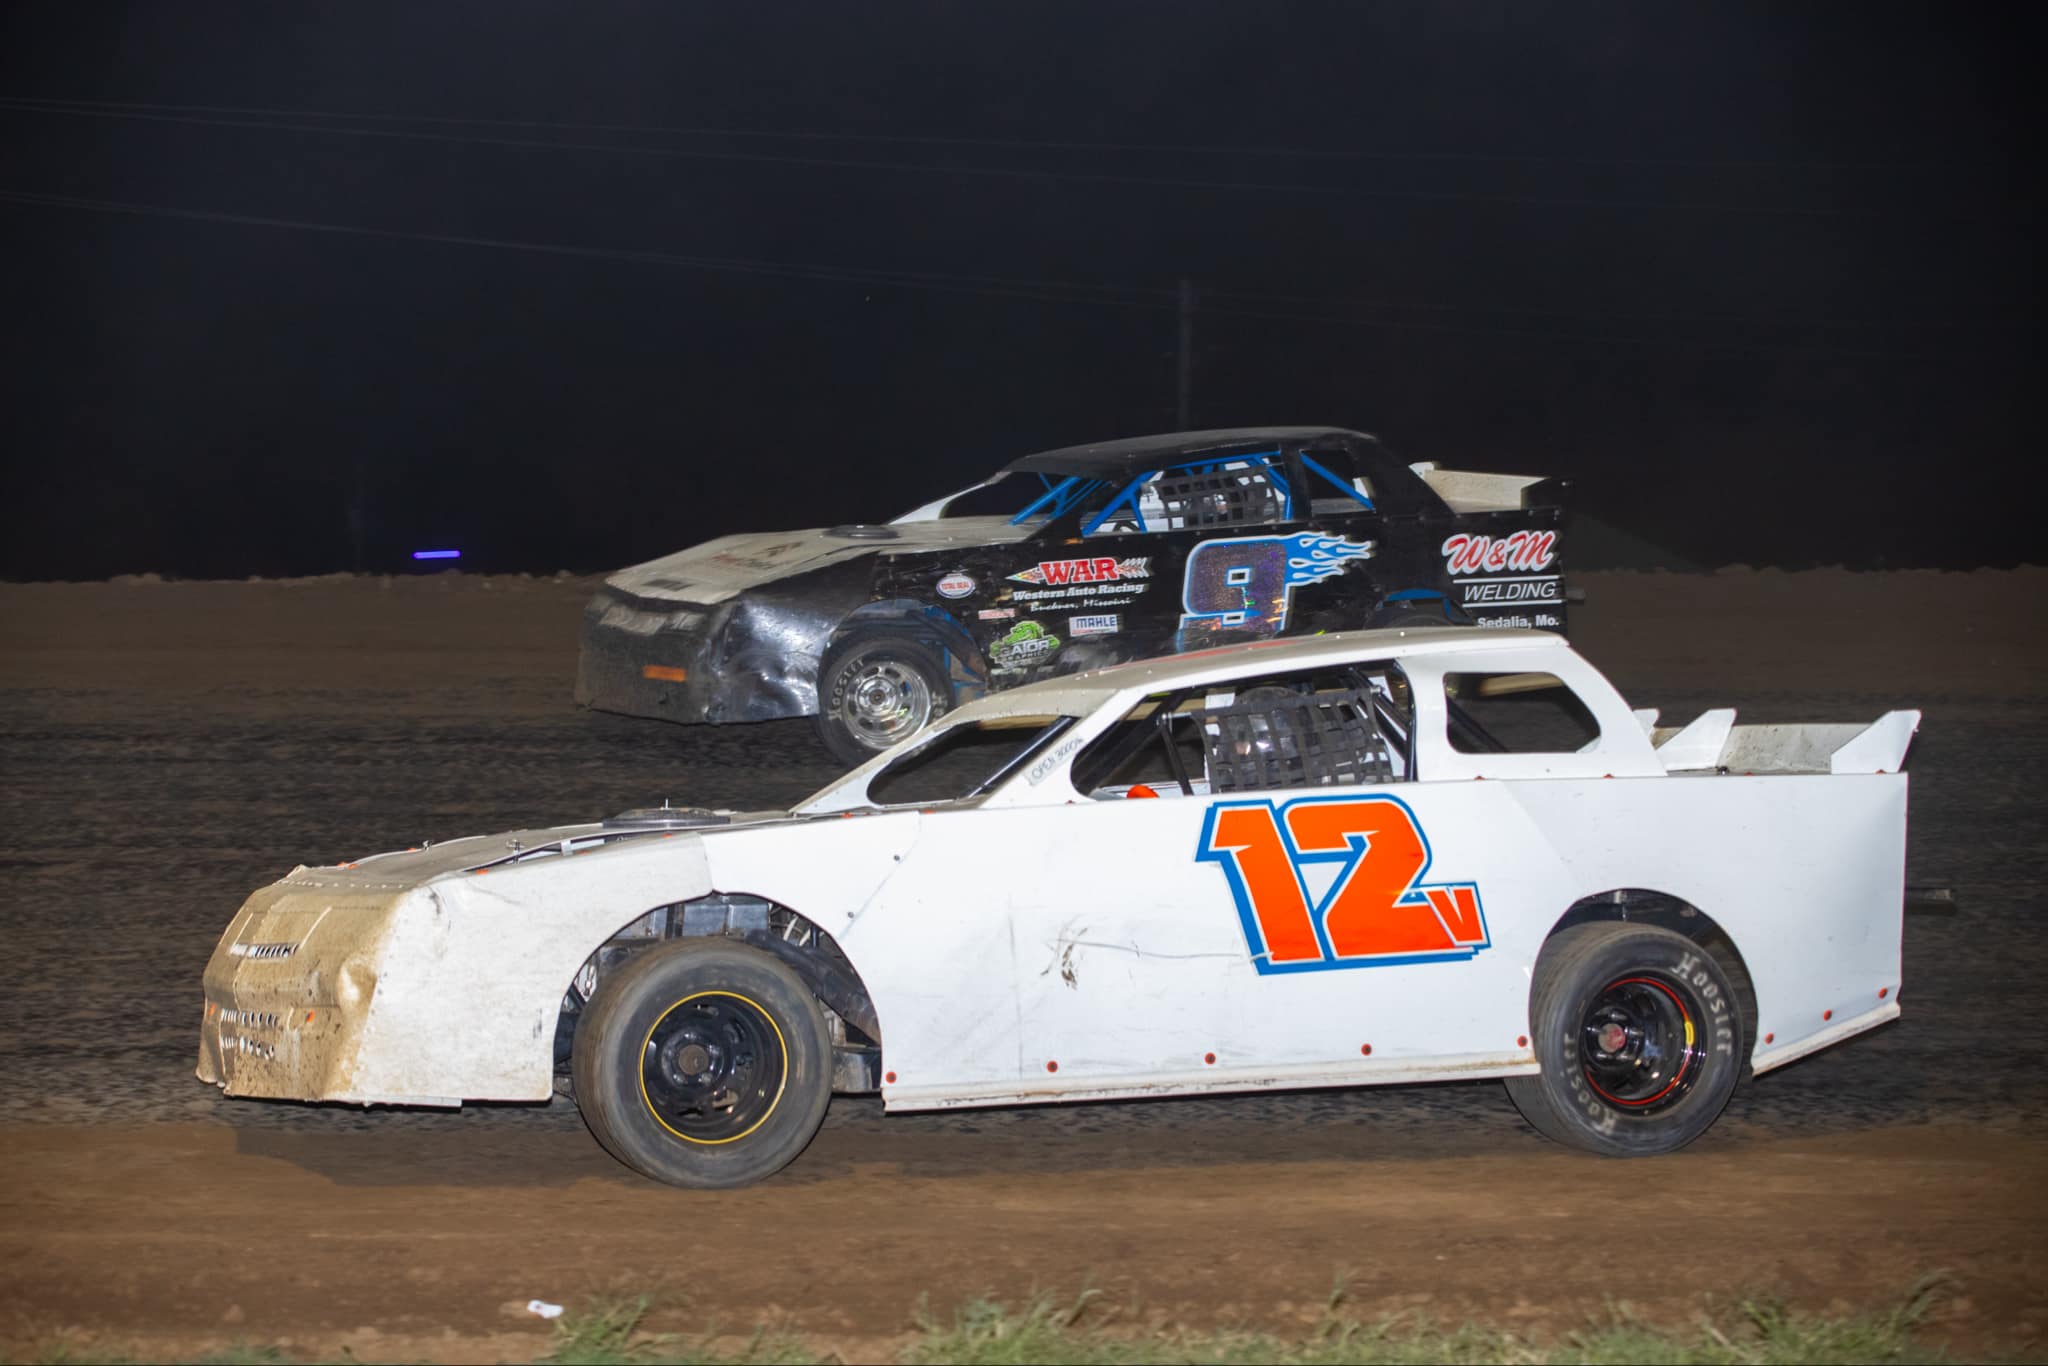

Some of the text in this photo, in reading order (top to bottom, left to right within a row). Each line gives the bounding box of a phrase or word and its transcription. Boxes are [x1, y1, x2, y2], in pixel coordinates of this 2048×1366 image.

[1441, 530, 1556, 575] W&M
[1038, 557, 1120, 585] WAR
[1013, 583, 1145, 601] Western Auto Racing
[1464, 581, 1557, 601] WELDING
[1075, 616, 1117, 628] MAHLE
[1477, 614, 1560, 629] Sedalia, Mo.
[1001, 640, 1049, 657] GATOR
